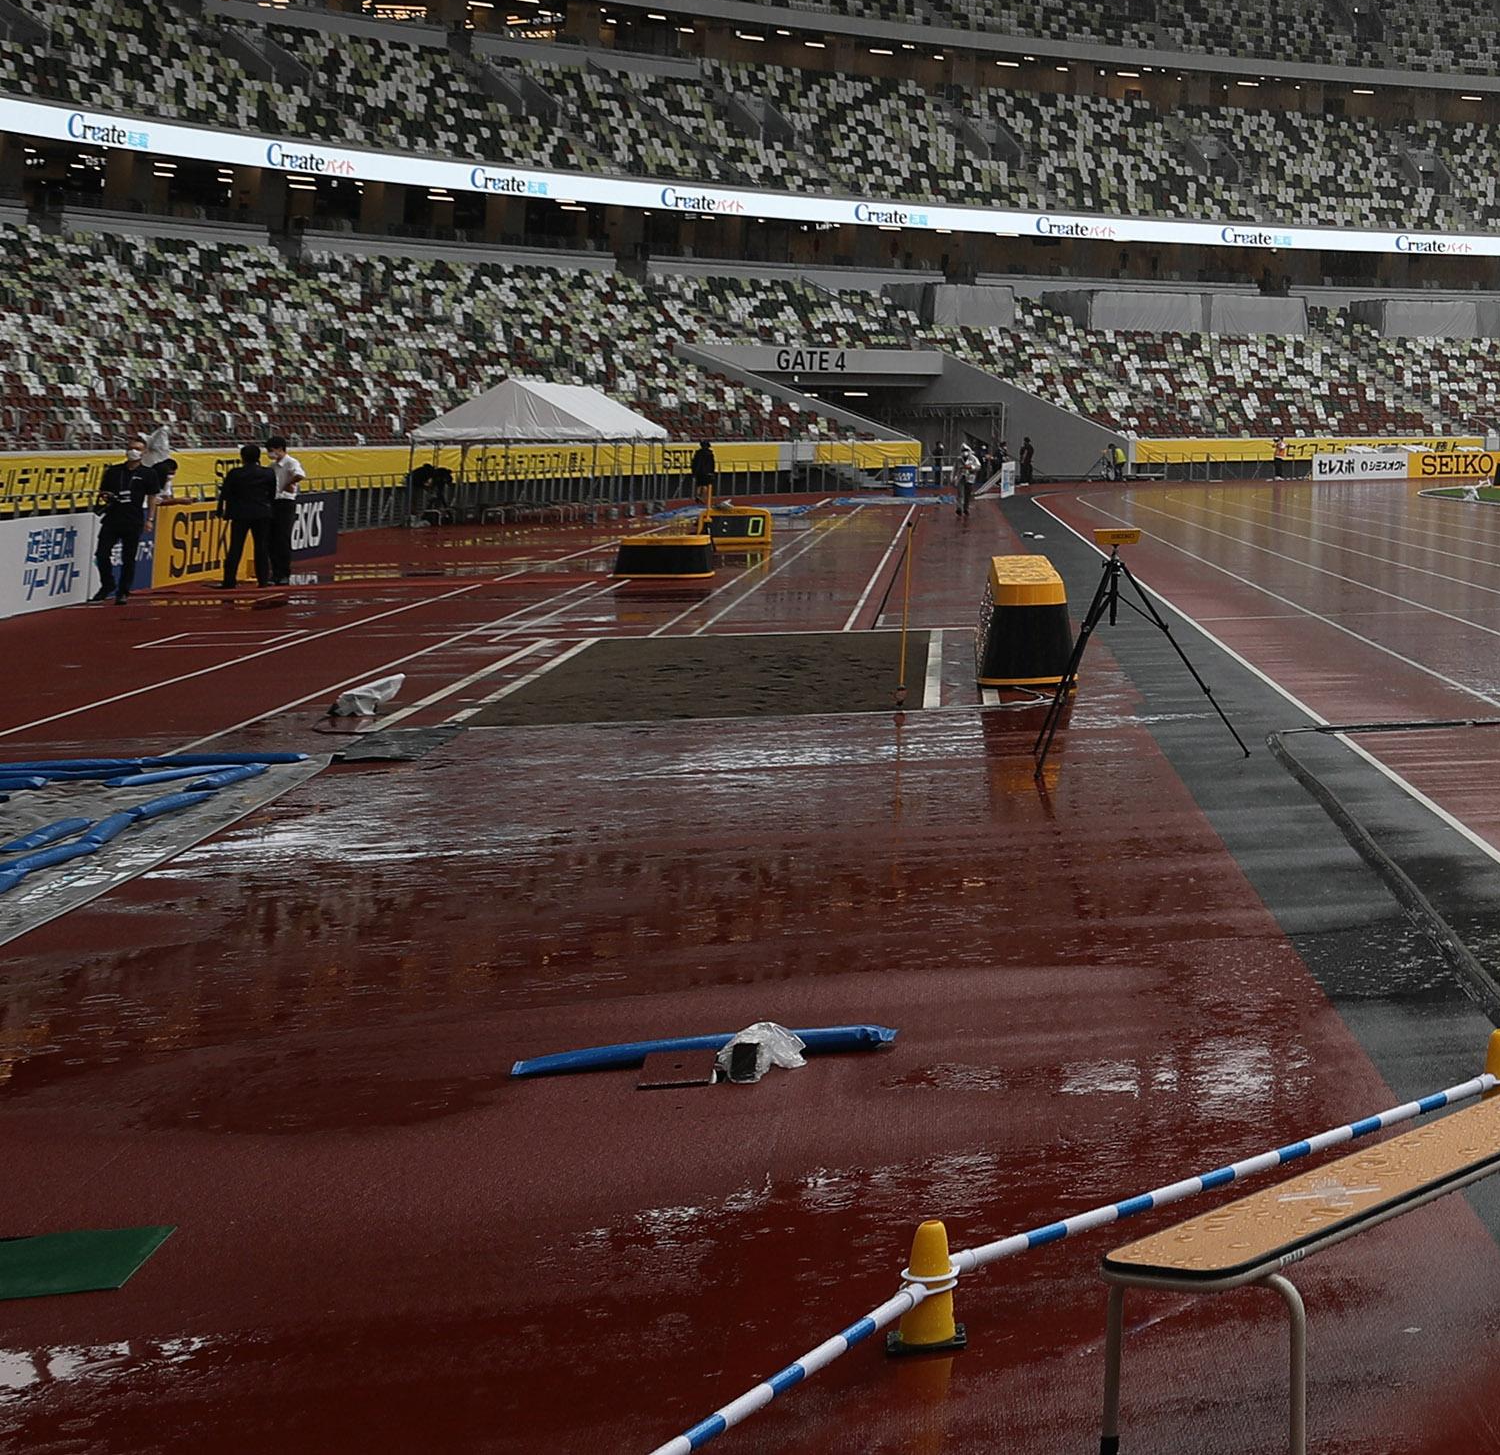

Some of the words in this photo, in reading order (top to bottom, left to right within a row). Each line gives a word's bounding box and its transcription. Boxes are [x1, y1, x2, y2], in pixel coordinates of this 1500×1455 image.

[777, 349, 830, 371] GATE
[835, 351, 846, 371] 4
[663, 449, 694, 469] SEI
[1318, 459, 1356, 475] セレスポ
[1421, 454, 1494, 477] SEIKO
[291, 501, 324, 550] asics
[748, 517, 764, 537] 0
[25, 526, 78, 563] 近畿日本
[169, 509, 232, 578] SEIK
[23, 562, 80, 601] ツーリスト
